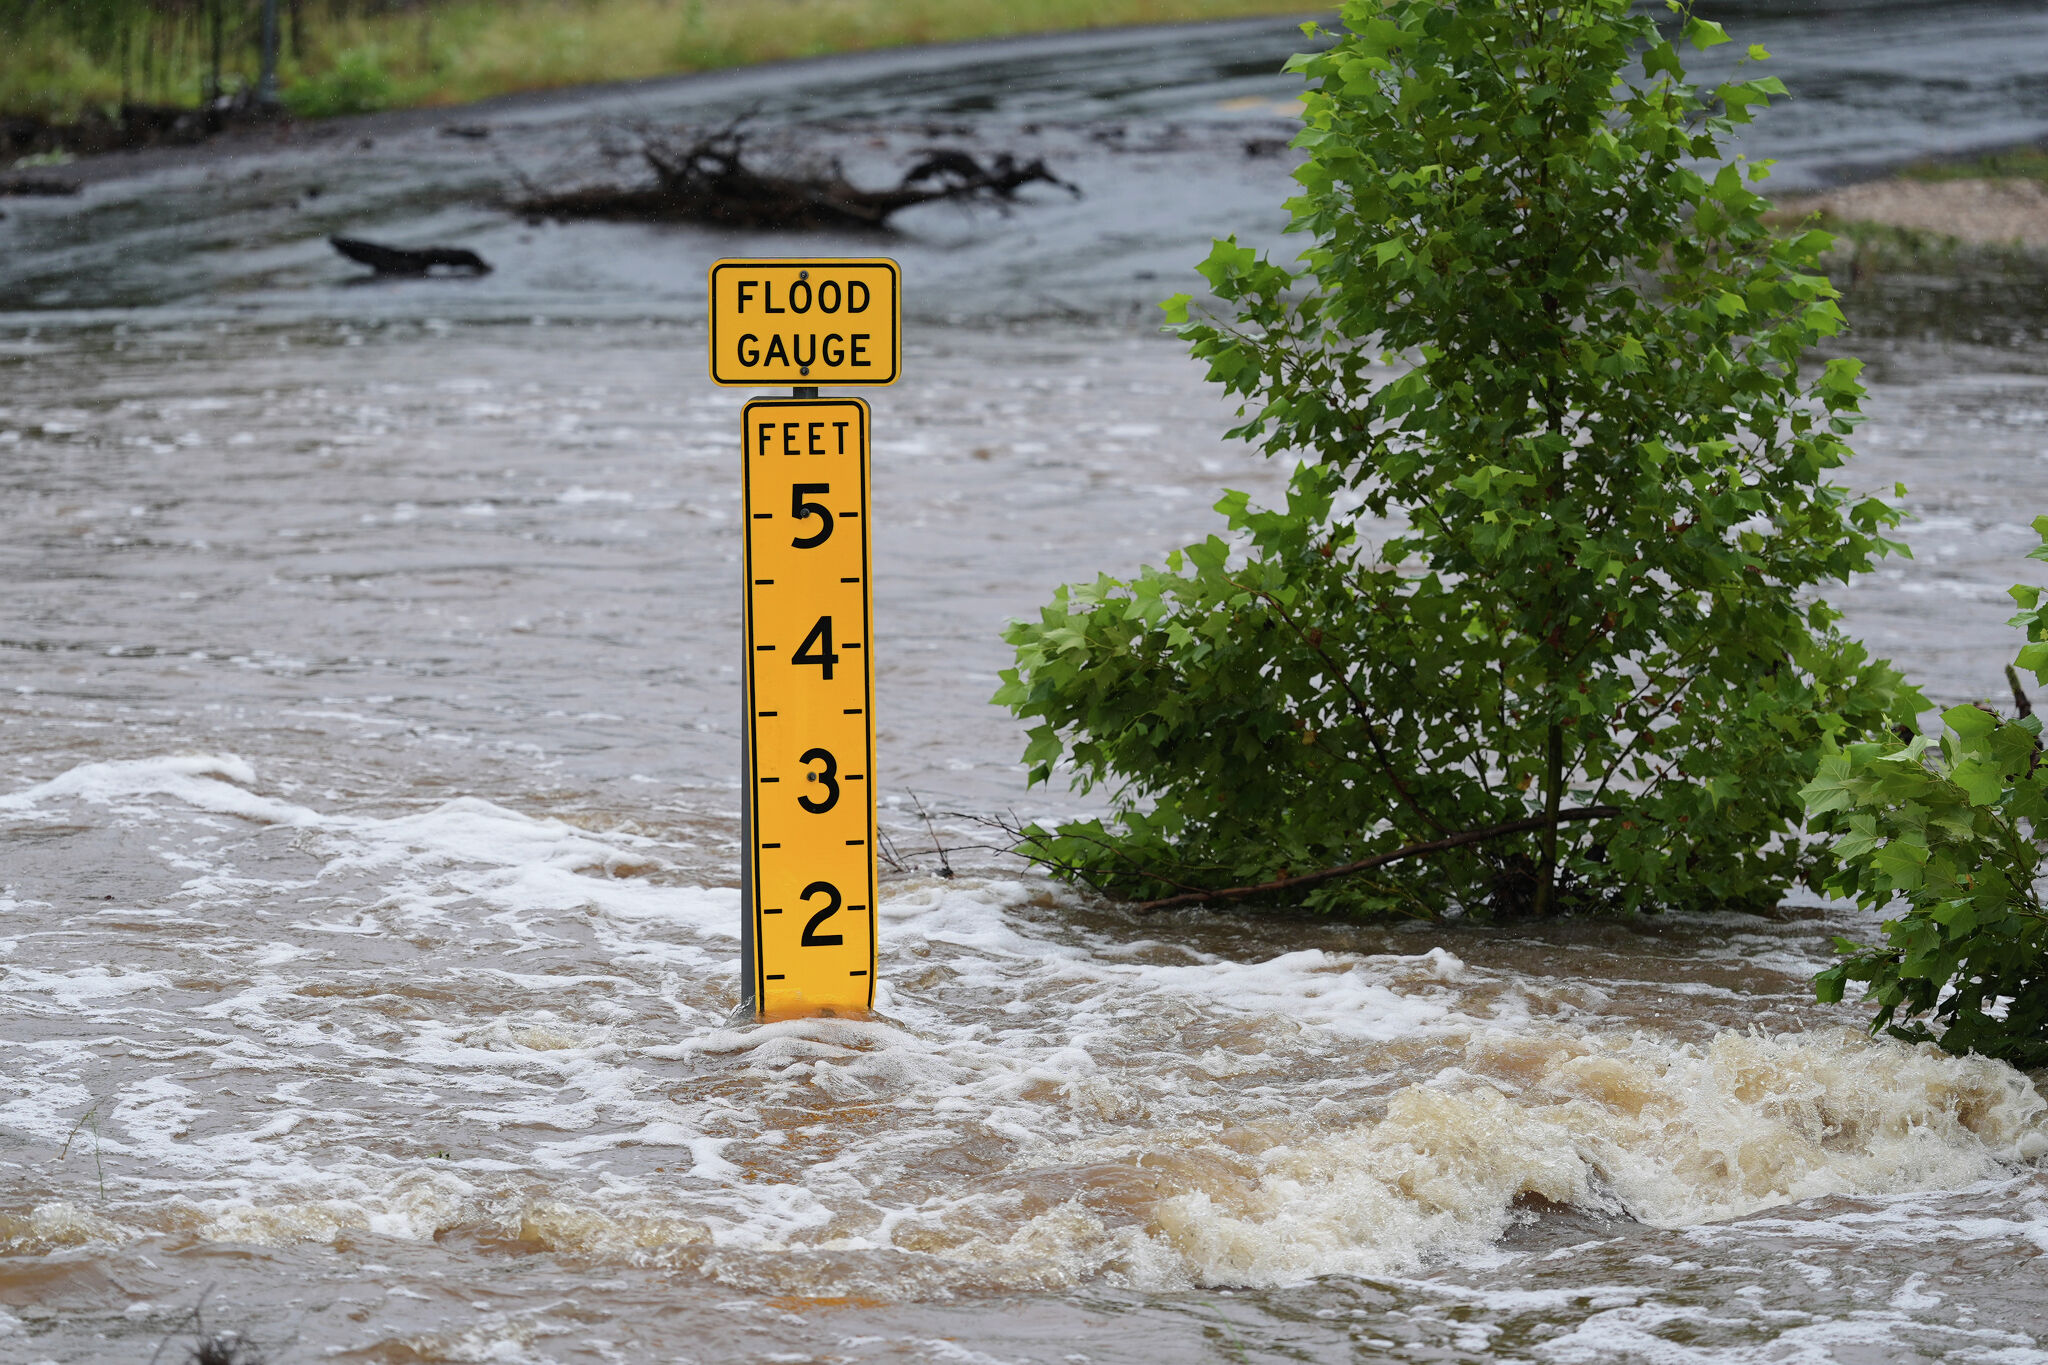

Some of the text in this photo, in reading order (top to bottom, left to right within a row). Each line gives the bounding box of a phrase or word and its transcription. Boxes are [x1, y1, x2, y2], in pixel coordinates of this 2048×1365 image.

[737, 279, 871, 314] FLOOD
[737, 333, 872, 368] GAUGE
[758, 421, 850, 456] FEET
[790, 482, 835, 550] 5
[791, 615, 839, 681] 4
[797, 747, 840, 815] 3
[799, 880, 844, 947] 2
